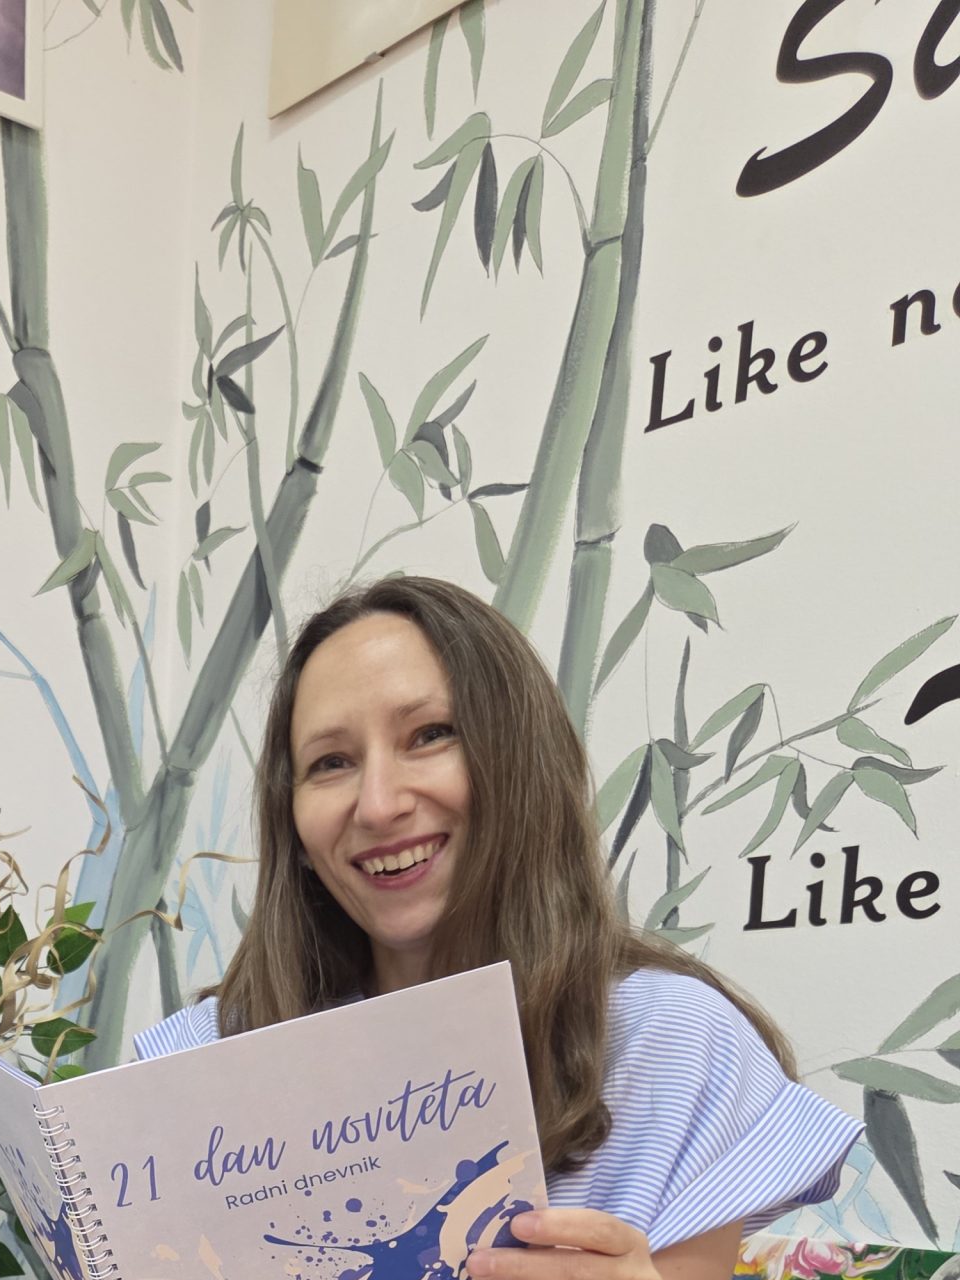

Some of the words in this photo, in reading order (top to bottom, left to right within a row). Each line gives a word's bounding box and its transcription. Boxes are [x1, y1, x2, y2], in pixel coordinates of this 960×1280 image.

[645, 321, 829, 433] Like
[890, 283, 960, 347] n
[744, 846, 941, 931] Like
[111, 1155, 162, 1208] 21
[193, 1125, 286, 1187] dan
[312, 1068, 497, 1154] noviteta
[225, 1181, 288, 1210] Radni
[294, 1155, 382, 1192] dnevnik
